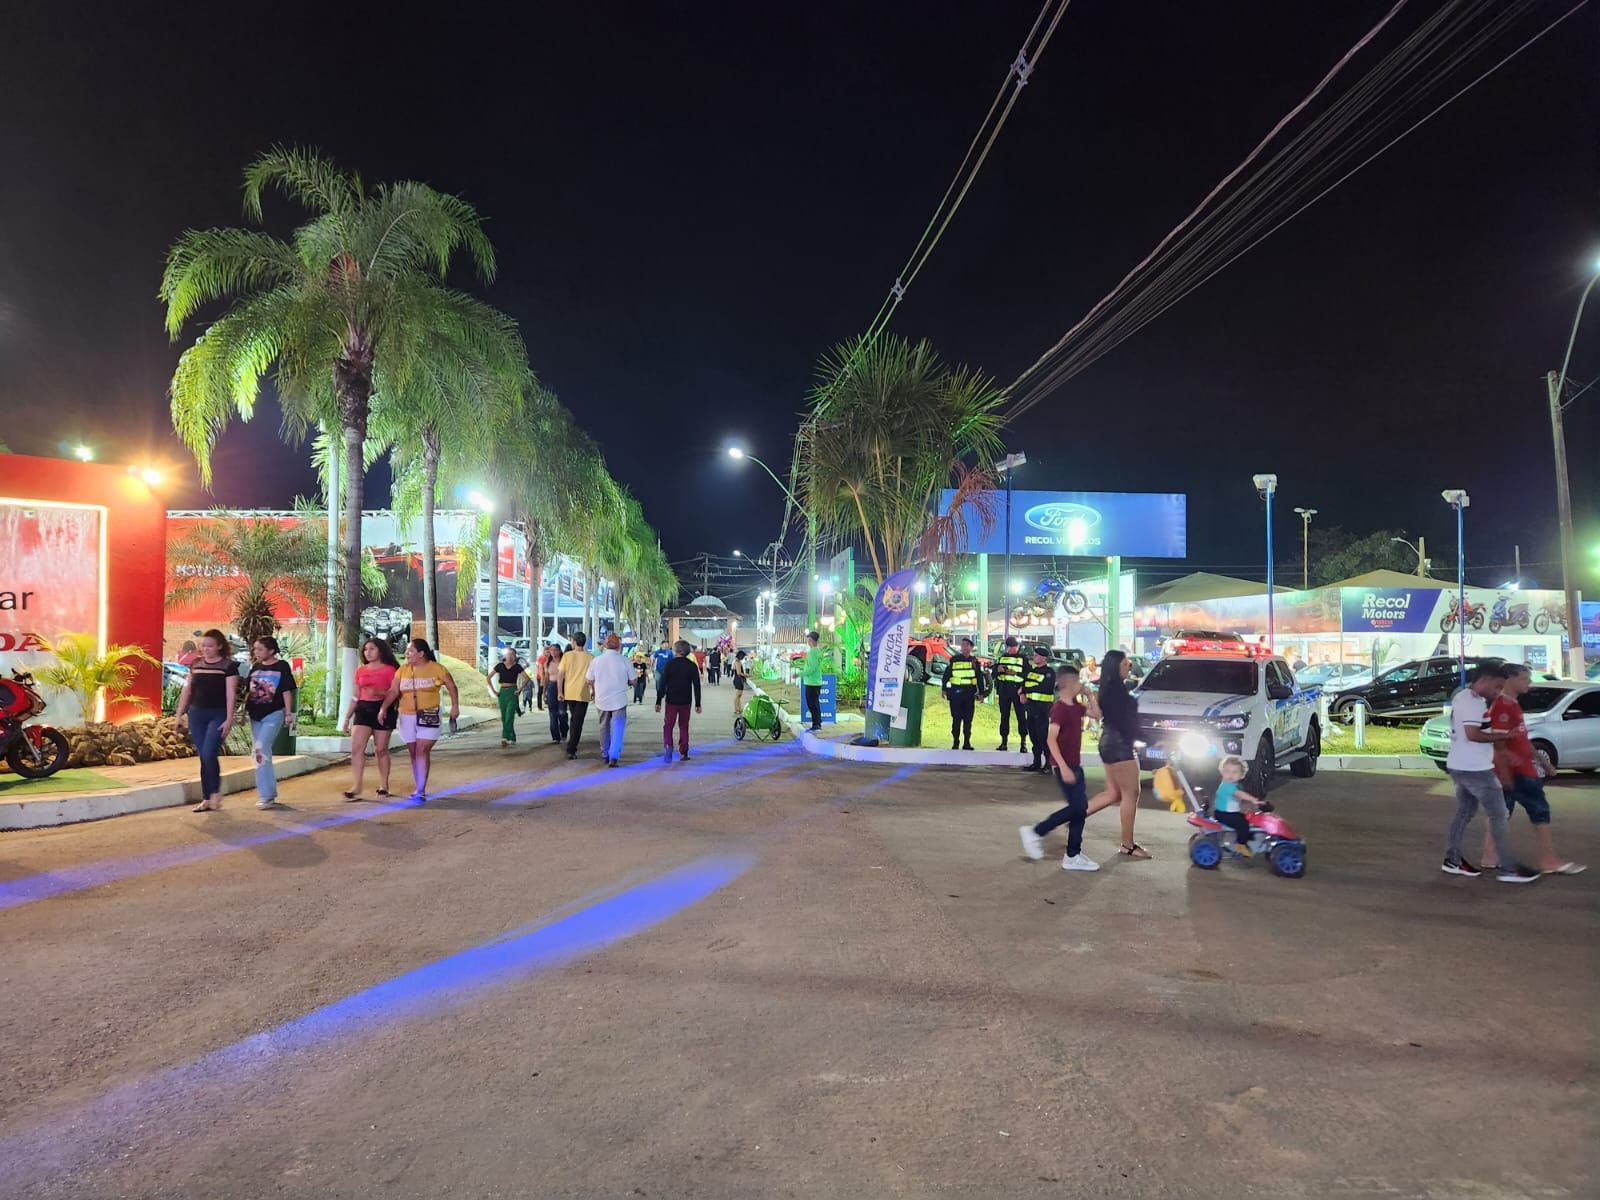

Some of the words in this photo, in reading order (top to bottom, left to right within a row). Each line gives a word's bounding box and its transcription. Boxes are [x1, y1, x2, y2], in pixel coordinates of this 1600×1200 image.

[1025, 536, 1055, 545] RECOL
[1362, 593, 1411, 609] Recol
[1362, 608, 1406, 619] Motors
[893, 624, 904, 666] MILITAR
